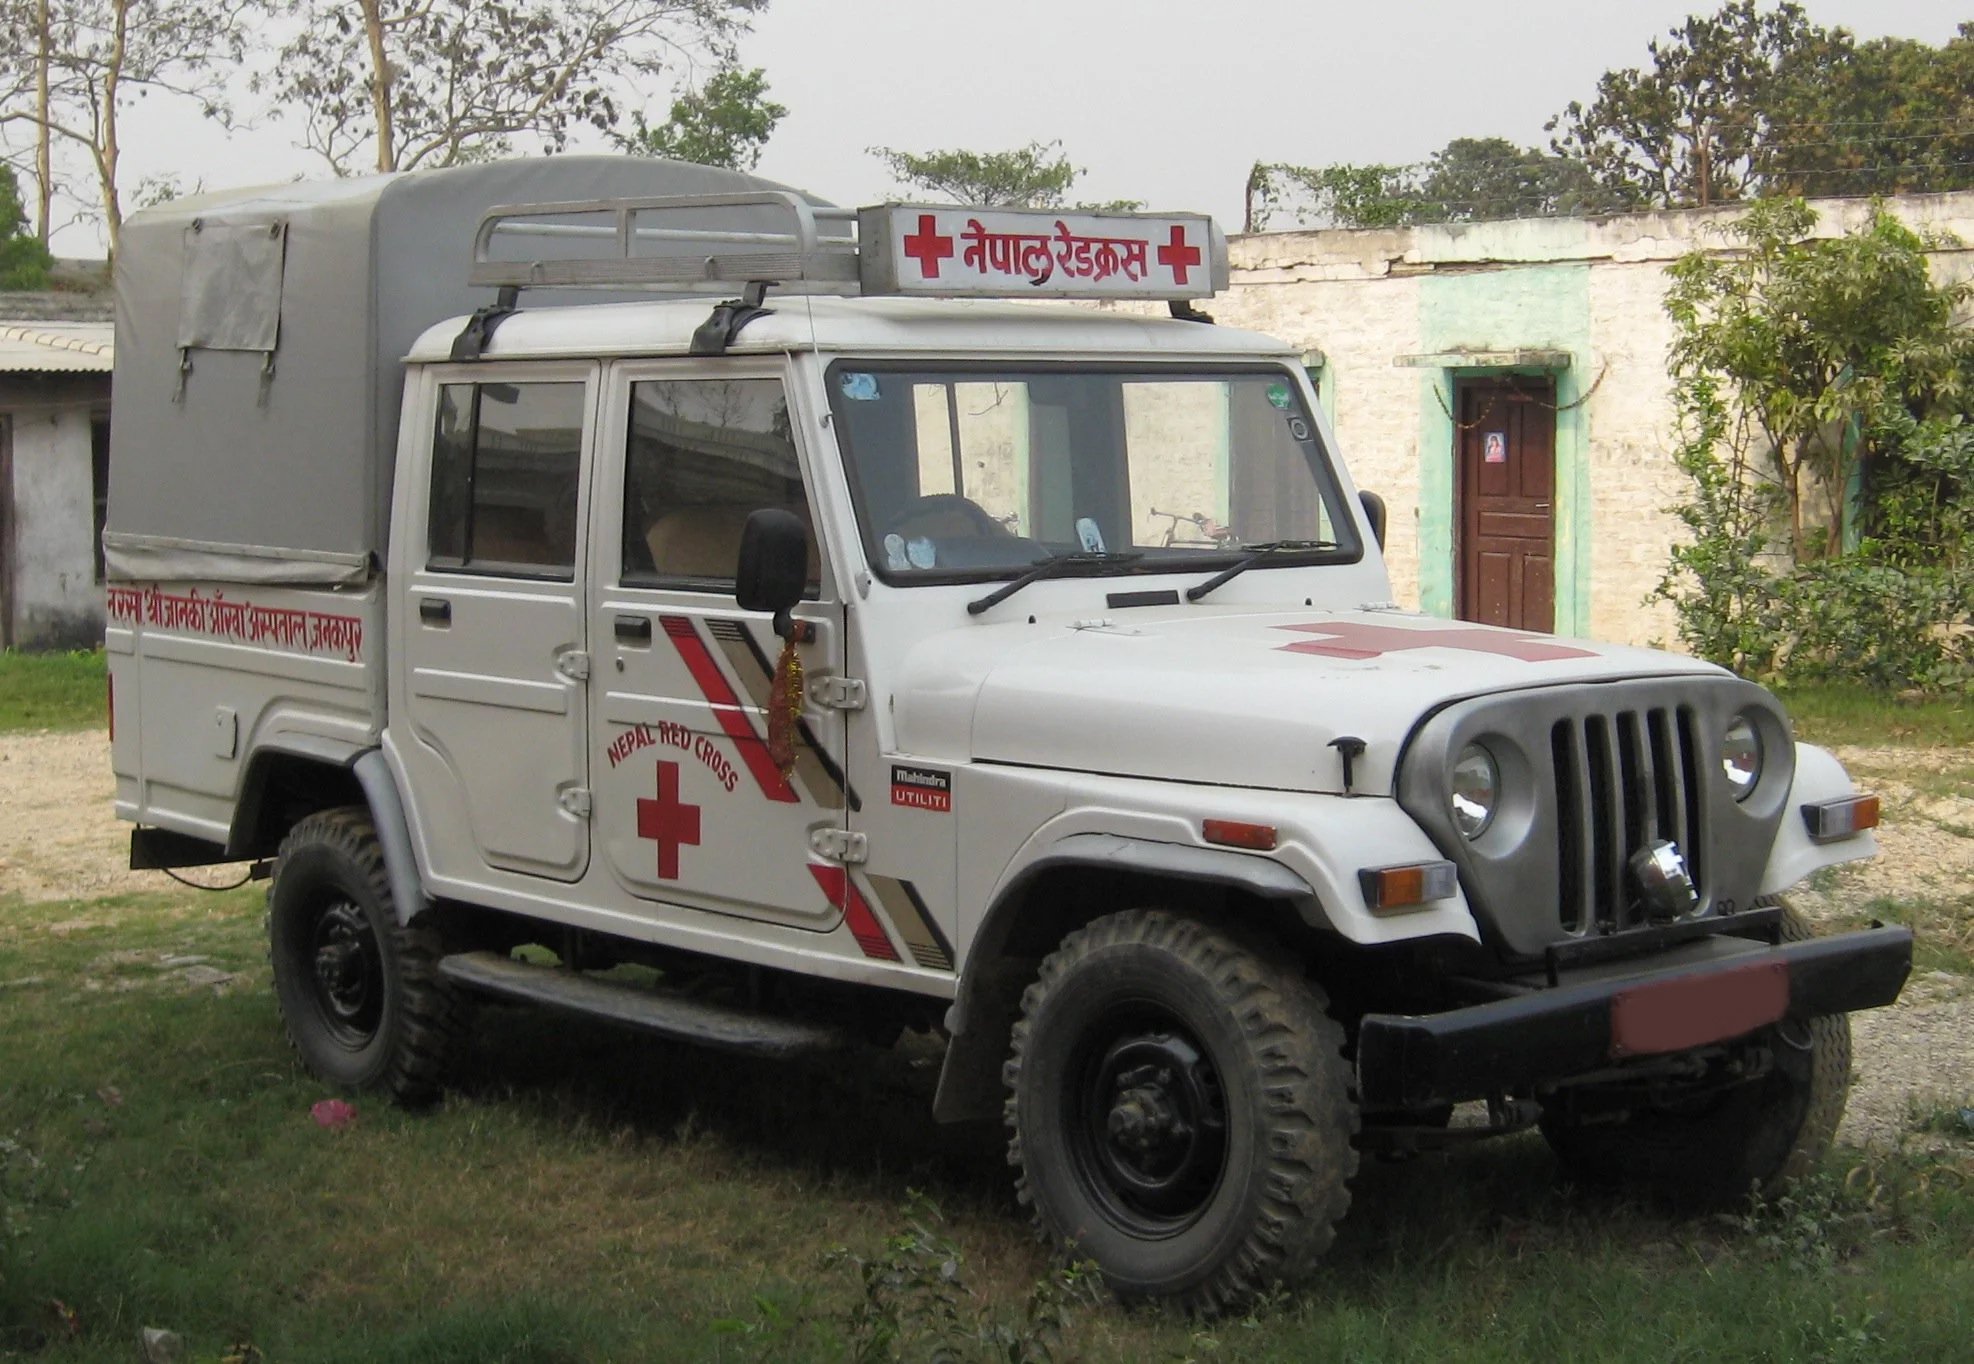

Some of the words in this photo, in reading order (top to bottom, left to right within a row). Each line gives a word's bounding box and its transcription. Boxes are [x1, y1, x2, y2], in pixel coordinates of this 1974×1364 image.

[1053, 219, 1149, 283] रेडक्रस
[163, 587, 205, 632] जानकी
[607, 722, 656, 768] NEPAL
[658, 720, 691, 750] RED
[694, 736, 738, 792] CROSS
[896, 769, 946, 788] Mahindra
[896, 790, 946, 808] UTILITI
